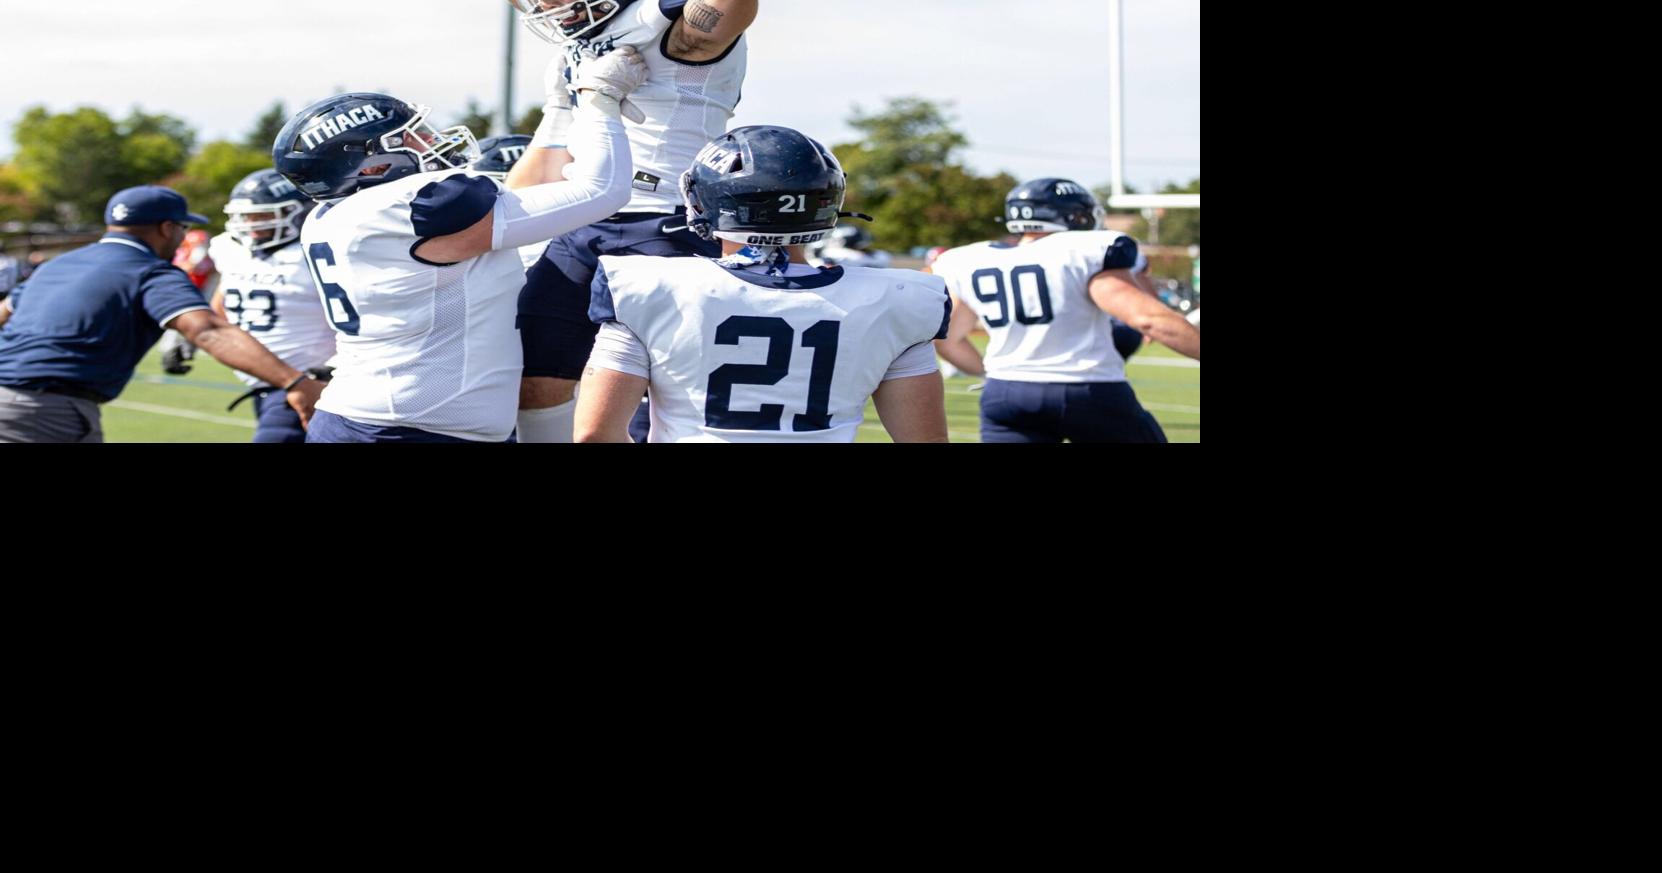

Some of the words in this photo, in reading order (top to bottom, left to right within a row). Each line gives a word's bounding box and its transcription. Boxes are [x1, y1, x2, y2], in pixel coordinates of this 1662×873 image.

[301, 104, 384, 150] ITHACA
[778, 194, 806, 213] 21
[747, 235, 784, 245] ONE
[789, 232, 825, 245] BEAT
[972, 264, 1054, 328] 90
[705, 316, 840, 432] 21
